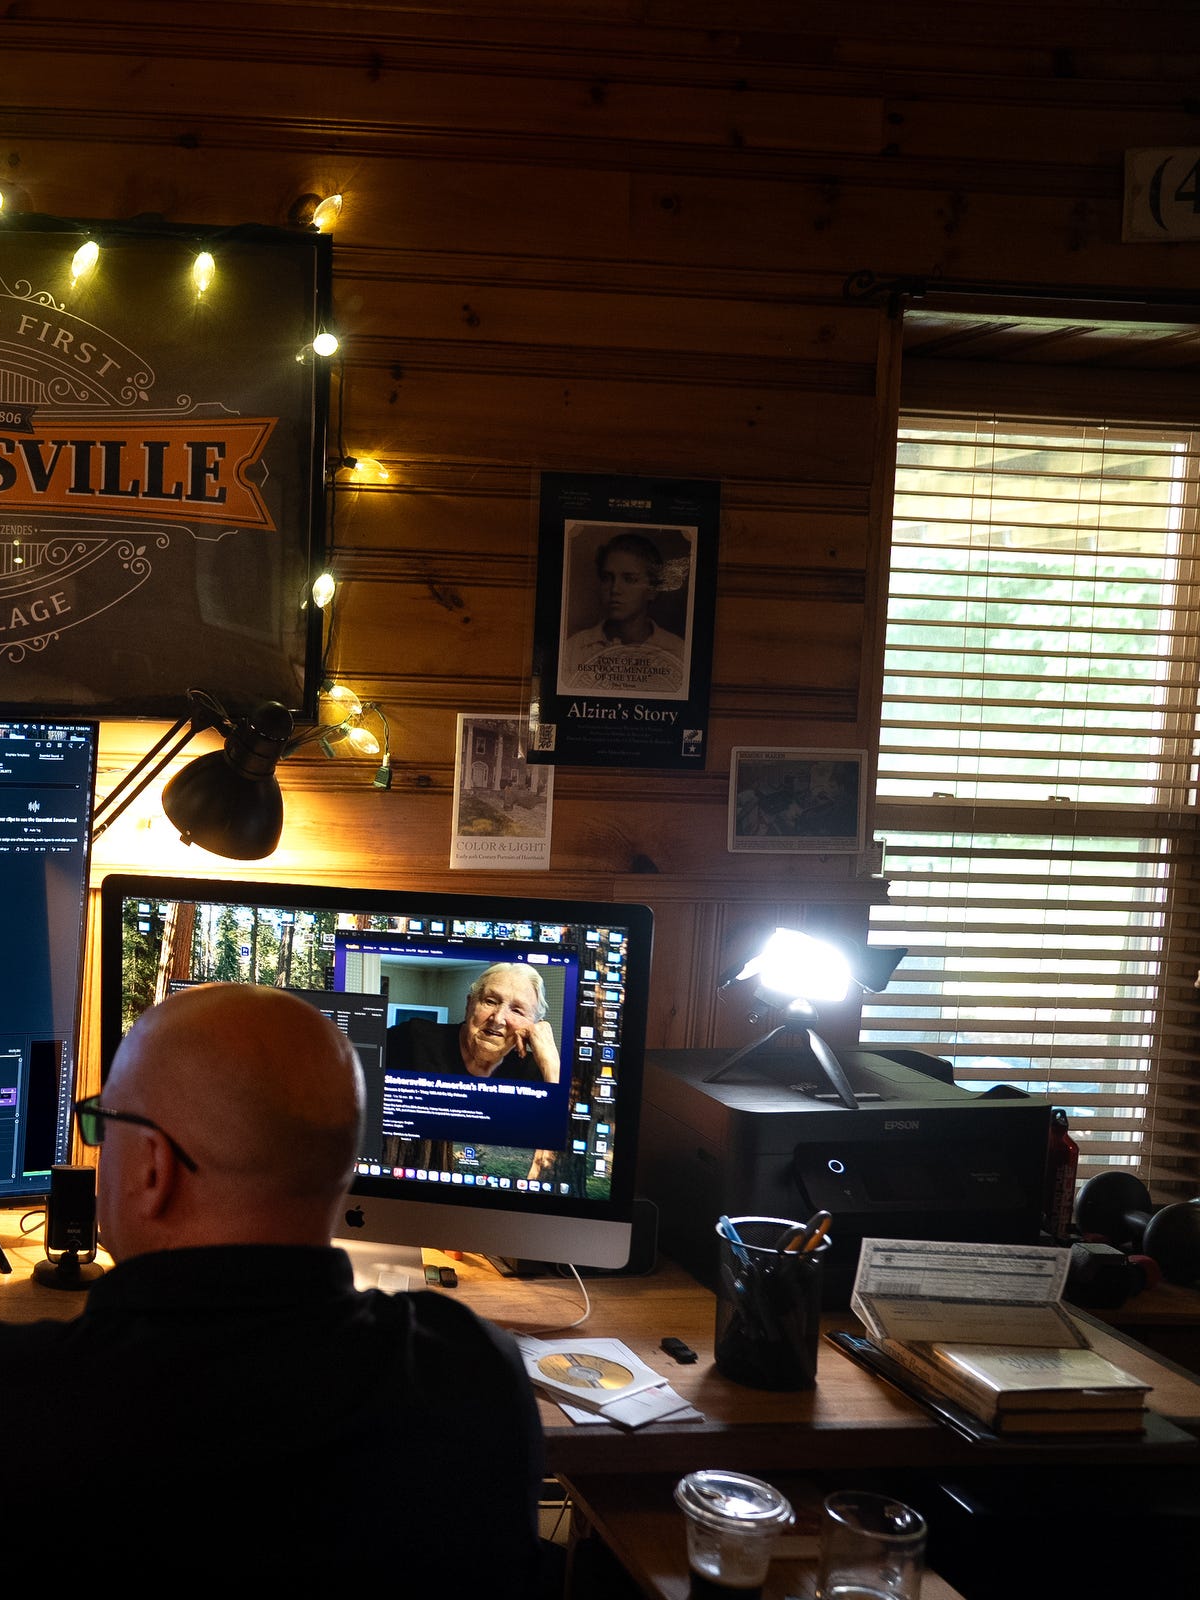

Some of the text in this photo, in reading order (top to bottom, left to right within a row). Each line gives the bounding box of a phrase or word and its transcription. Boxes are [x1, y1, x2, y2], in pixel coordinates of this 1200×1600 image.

[17, 313, 121, 378] FIRST
[567, 701, 679, 725] Alzira's Story
[456, 841, 546, 852] COLOR & LIGHT
[435, 1079, 477, 1091] America's
[478, 1083, 498, 1093] First
[516, 1086, 548, 1098] Village
[884, 1120, 920, 1130] EPSON
